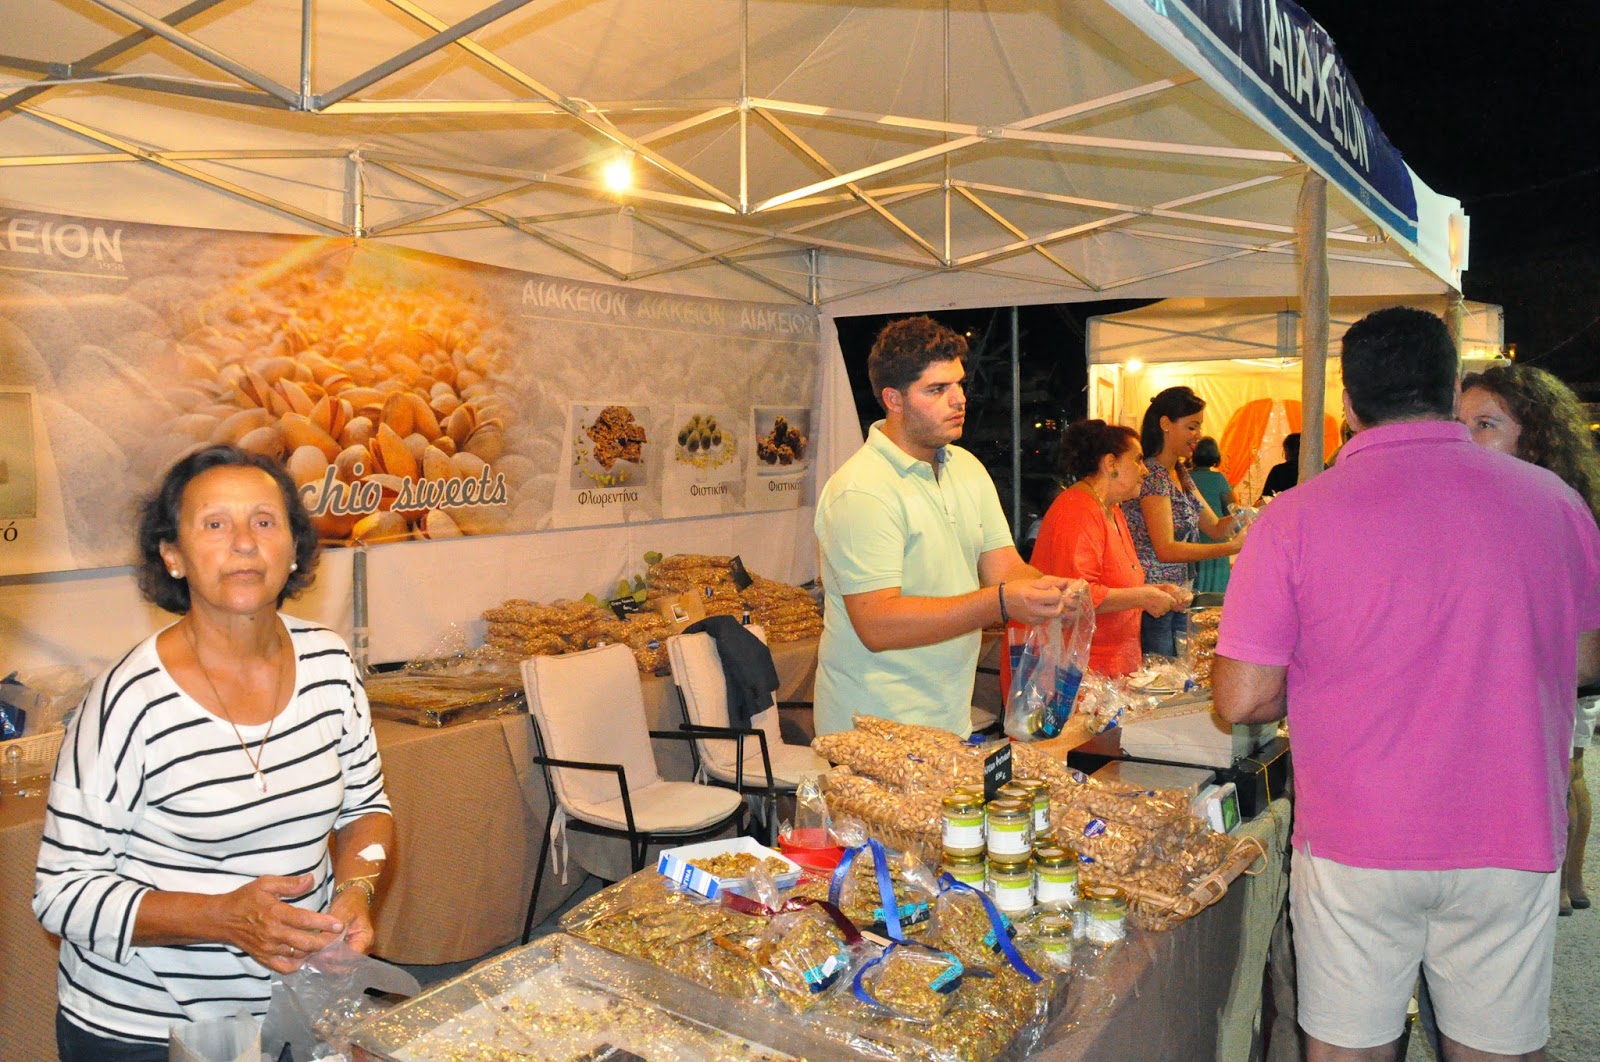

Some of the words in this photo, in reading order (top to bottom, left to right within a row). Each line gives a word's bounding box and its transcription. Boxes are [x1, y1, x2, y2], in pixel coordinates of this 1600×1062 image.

[0, 217, 123, 263] ΕΙΟΝ
[522, 279, 626, 316] ΑΙΑΚΕΙΟΝ
[390, 463, 508, 512] sweets
[578, 488, 639, 509] Φλωρεντίνα
